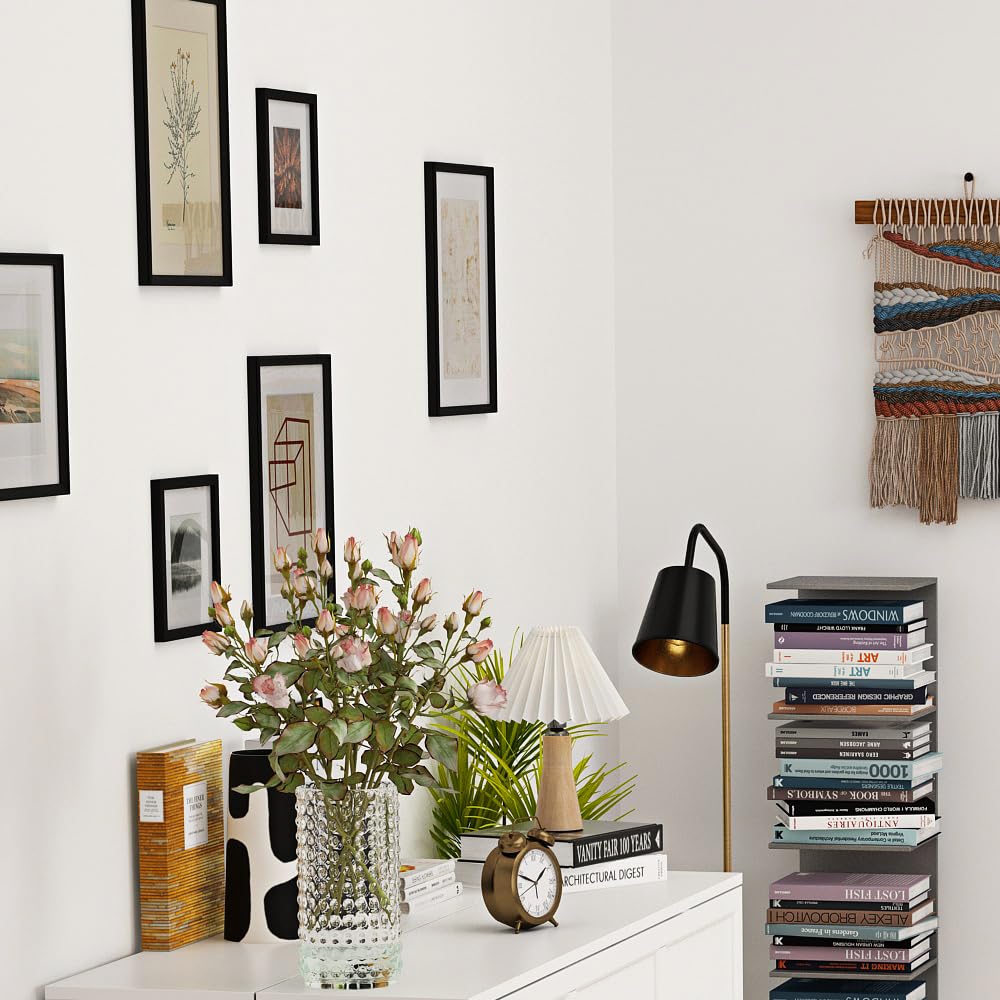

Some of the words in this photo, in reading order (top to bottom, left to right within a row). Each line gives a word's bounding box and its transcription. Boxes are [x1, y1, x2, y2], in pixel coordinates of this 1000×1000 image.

[842, 609, 898, 620] WINDOWS
[858, 653, 879, 662] ART
[849, 667, 870, 676] ART
[869, 764, 909, 778] 1000
[787, 790, 838, 799] SYMBOLS
[850, 791, 878, 800] BOOK
[827, 820, 898, 828] ANTIQUAIRES
[576, 841, 603, 863] VANITY
[604, 838, 618, 859] FAIR
[620, 837, 629, 855] 100
[631, 832, 651, 853] YEARS
[561, 870, 617, 887] RCHITECTURAL
[619, 866, 644, 880] DIGEST
[845, 889, 871, 899] FISH
[874, 890, 905, 900] LOST
[776, 911, 856, 923] BRODOVITCH
[860, 913, 909, 924] ALEXEY
[832, 929, 859, 937] Gardens
[846, 950, 871, 959] FISH
[874, 950, 905, 959] LOST
